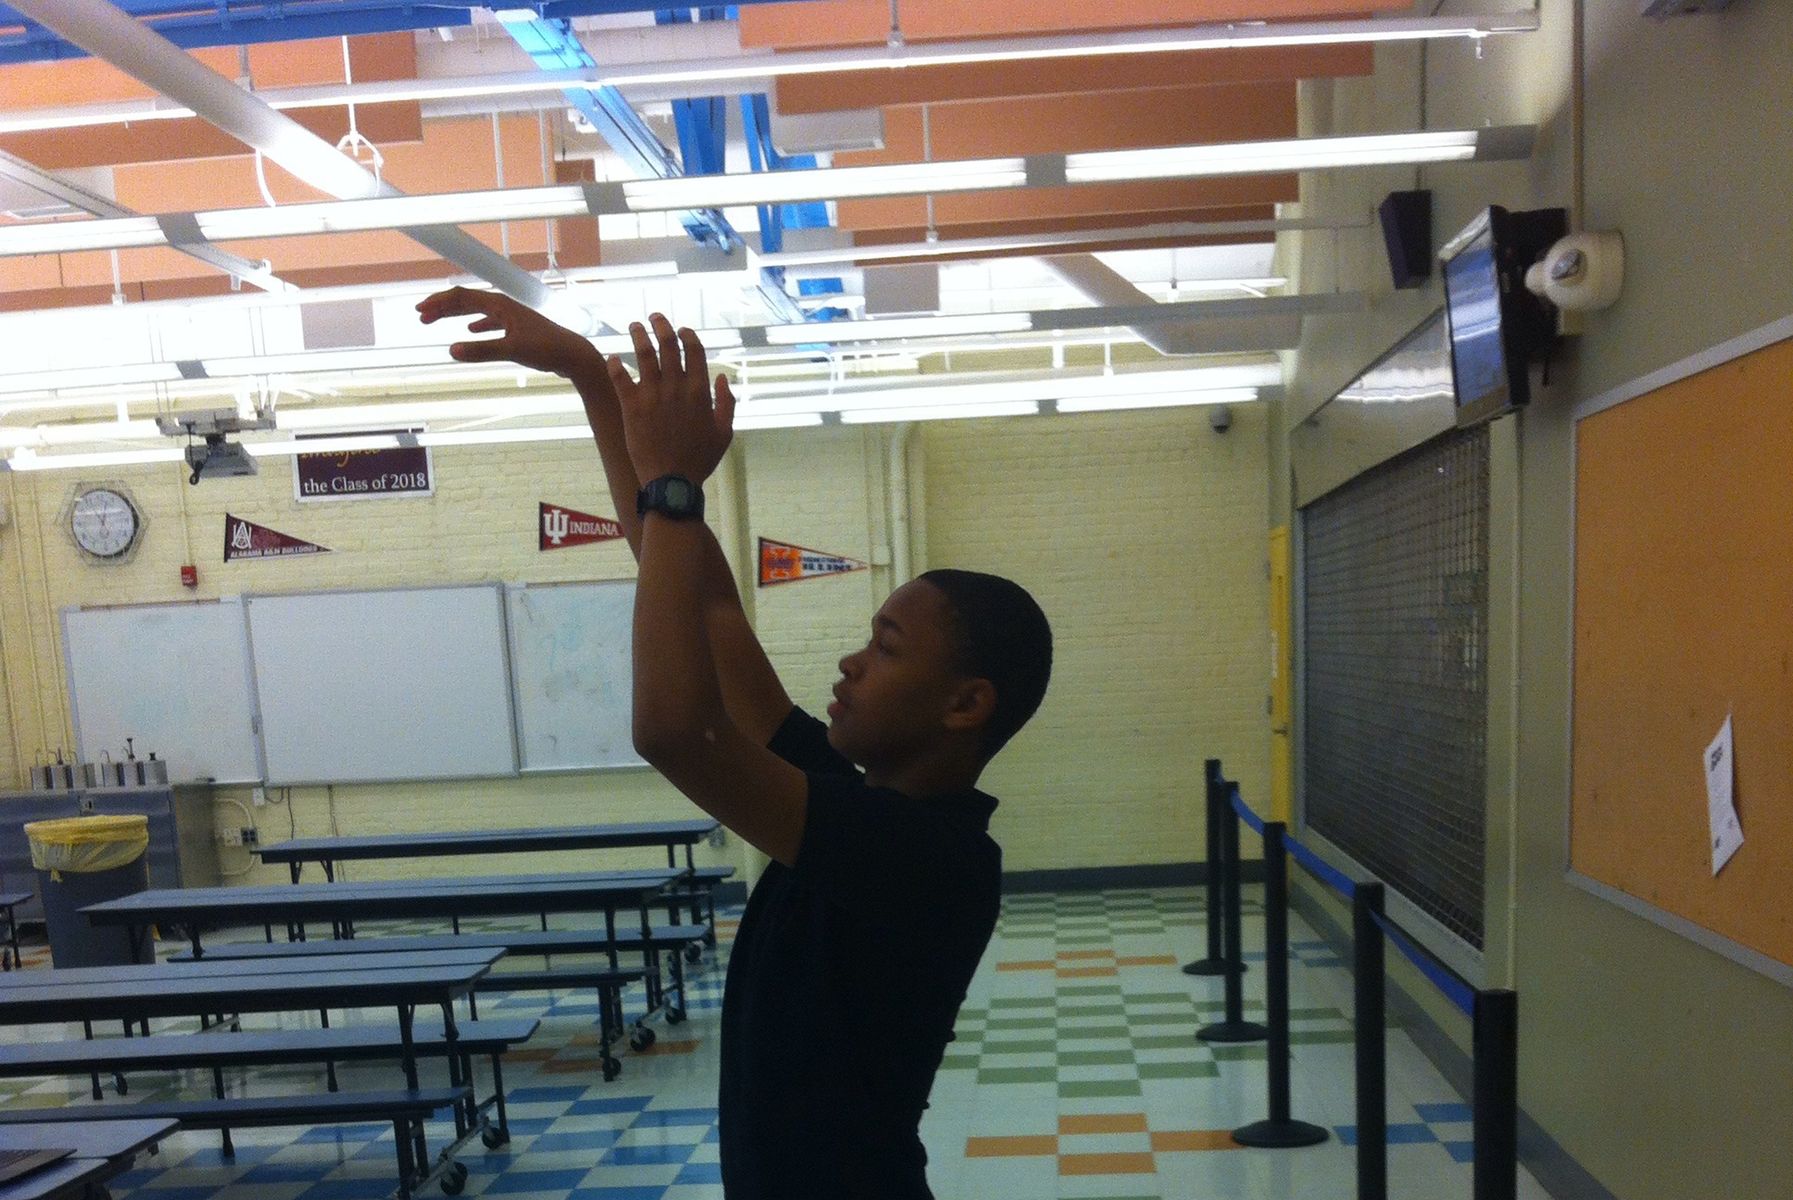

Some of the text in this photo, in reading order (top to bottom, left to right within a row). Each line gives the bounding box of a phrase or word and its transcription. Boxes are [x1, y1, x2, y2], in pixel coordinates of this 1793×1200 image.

[304, 472, 426, 494] the Class of 2018
[569, 521, 619, 536] INDIANA
